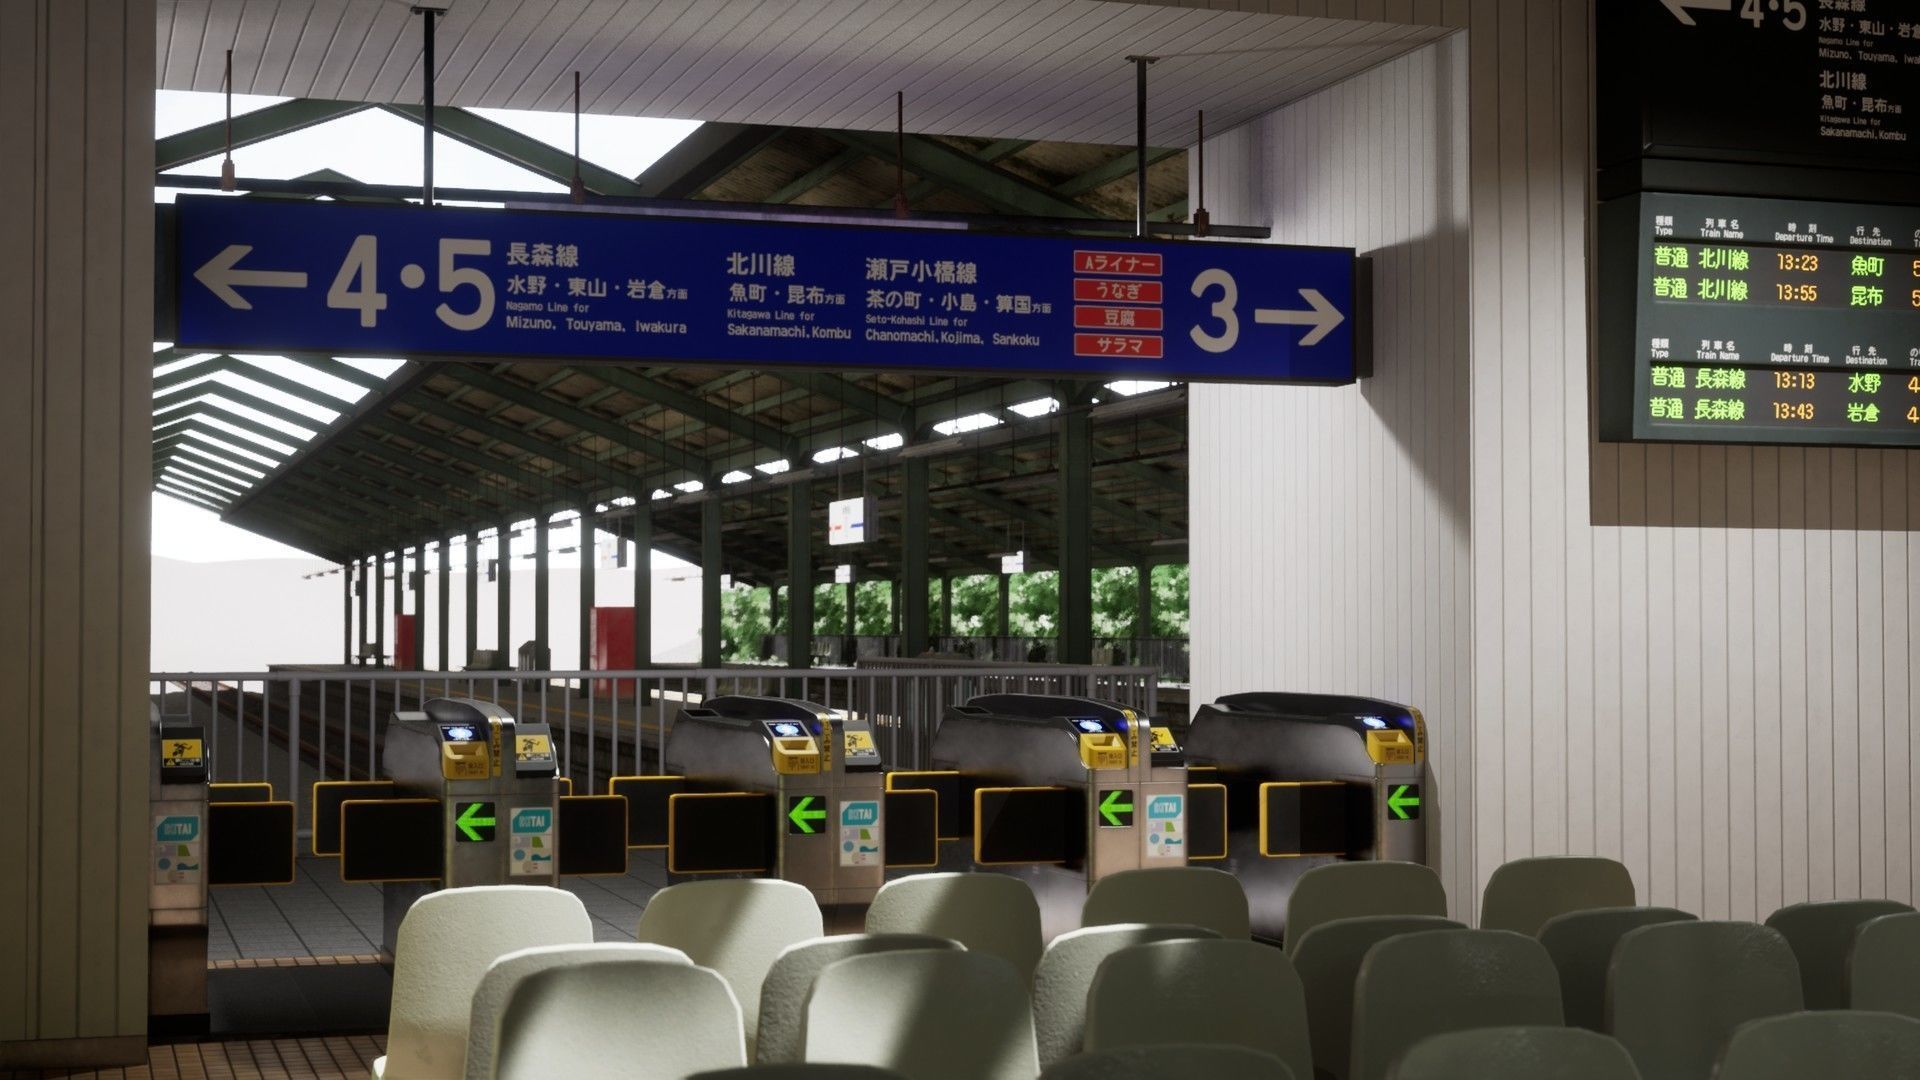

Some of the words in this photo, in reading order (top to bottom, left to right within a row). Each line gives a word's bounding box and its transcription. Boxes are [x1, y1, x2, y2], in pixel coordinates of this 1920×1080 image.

[1846, 38, 1859, 46] Line
[1863, 39, 1874, 47] for
[1819, 70, 1867, 90] 北川線
[1853, 116, 1867, 125] Line
[1870, 117, 1881, 126] for
[1655, 226, 1673, 236] Type
[1700, 228, 1720, 238] Train
[1723, 229, 1744, 239] Name
[1775, 232, 1812, 243] Departure
[1816, 233, 1834, 244] Time
[1849, 236, 1892, 247] Destination
[506, 242, 579, 267] 長森線
[1085, 255, 1155, 272] Aライナー
[1654, 245, 1689, 268] 普通
[1698, 247, 1749, 270] 北川線
[1777, 253, 1818, 272] 13:23
[1851, 255, 1884, 277] 魚町
[727, 252, 795, 277] 北川線
[865, 257, 977, 284] 瀬戸小橋線
[1097, 282, 1142, 299] うなぎ
[1653, 276, 1688, 299] 普通
[1697, 278, 1749, 301] 北川線
[1776, 284, 1817, 301] 13:55
[1850, 285, 1884, 307] 昆布
[506, 301, 544, 312] Nagamo
[547, 302, 568, 313] Line
[573, 303, 590, 313] for
[727, 308, 771, 320] Kitagawa
[775, 310, 795, 321] Line
[800, 311, 815, 321] for
[1190, 268, 1239, 353] 3
[635, 320, 687, 334] Iwakura
[929, 316, 949, 326] Line
[953, 317, 968, 327] for
[1104, 309, 1135, 327] 豆腐
[992, 332, 1040, 346] Sankoku
[1097, 337, 1143, 353] サラマ
[1651, 348, 1669, 359] Type
[1696, 350, 1716, 360] Train
[1719, 351, 1740, 361] Name
[1771, 352, 1809, 363] Departure
[1812, 354, 1829, 364] Time
[1845, 355, 1888, 366] Destination
[1651, 366, 1685, 388] 普通
[1695, 367, 1746, 390] 長森線
[1774, 372, 1815, 389] 13:13
[1848, 372, 1882, 393] 水野
[1908, 376, 1920, 393] 4
[1650, 396, 1684, 419] 普通
[1694, 398, 1745, 420] 長森線
[1773, 402, 1814, 420] 13:43
[1847, 402, 1880, 422] 岩倉
[1906, 406, 1920, 423] 4
